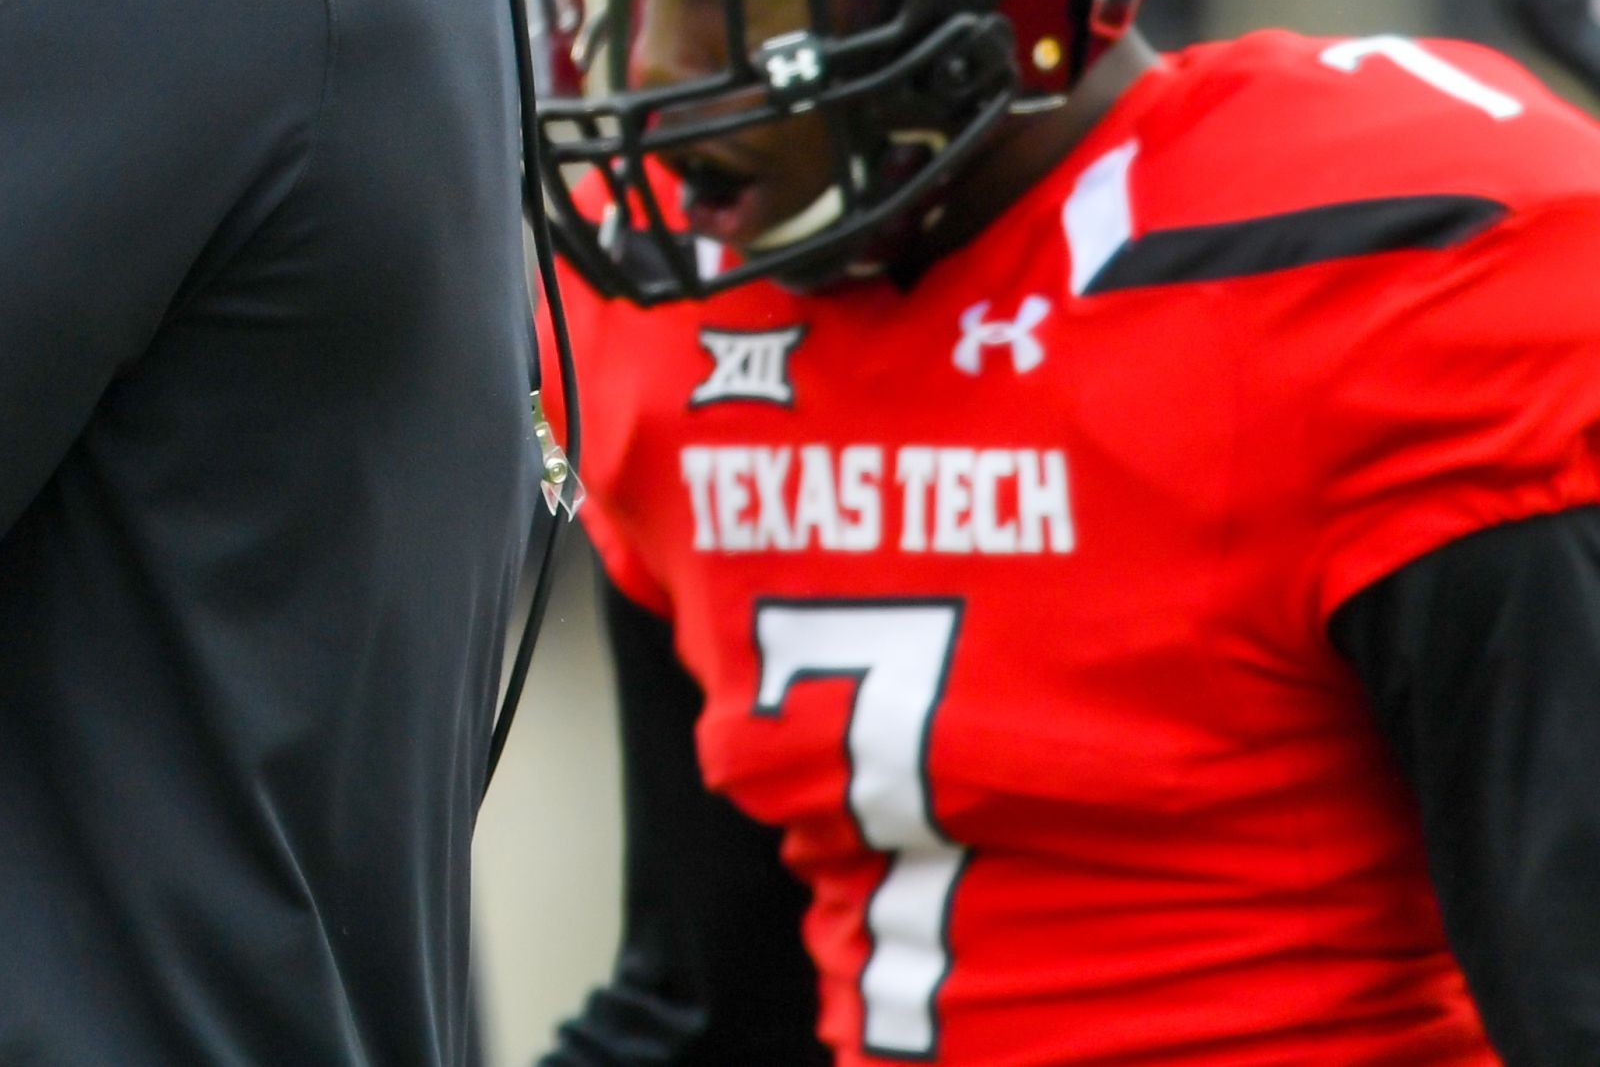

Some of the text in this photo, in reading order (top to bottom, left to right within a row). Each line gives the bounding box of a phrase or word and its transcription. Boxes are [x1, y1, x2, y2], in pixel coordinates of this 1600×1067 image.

[680, 444, 1076, 554] TEXAS TECH
[752, 596, 977, 1062] 7
